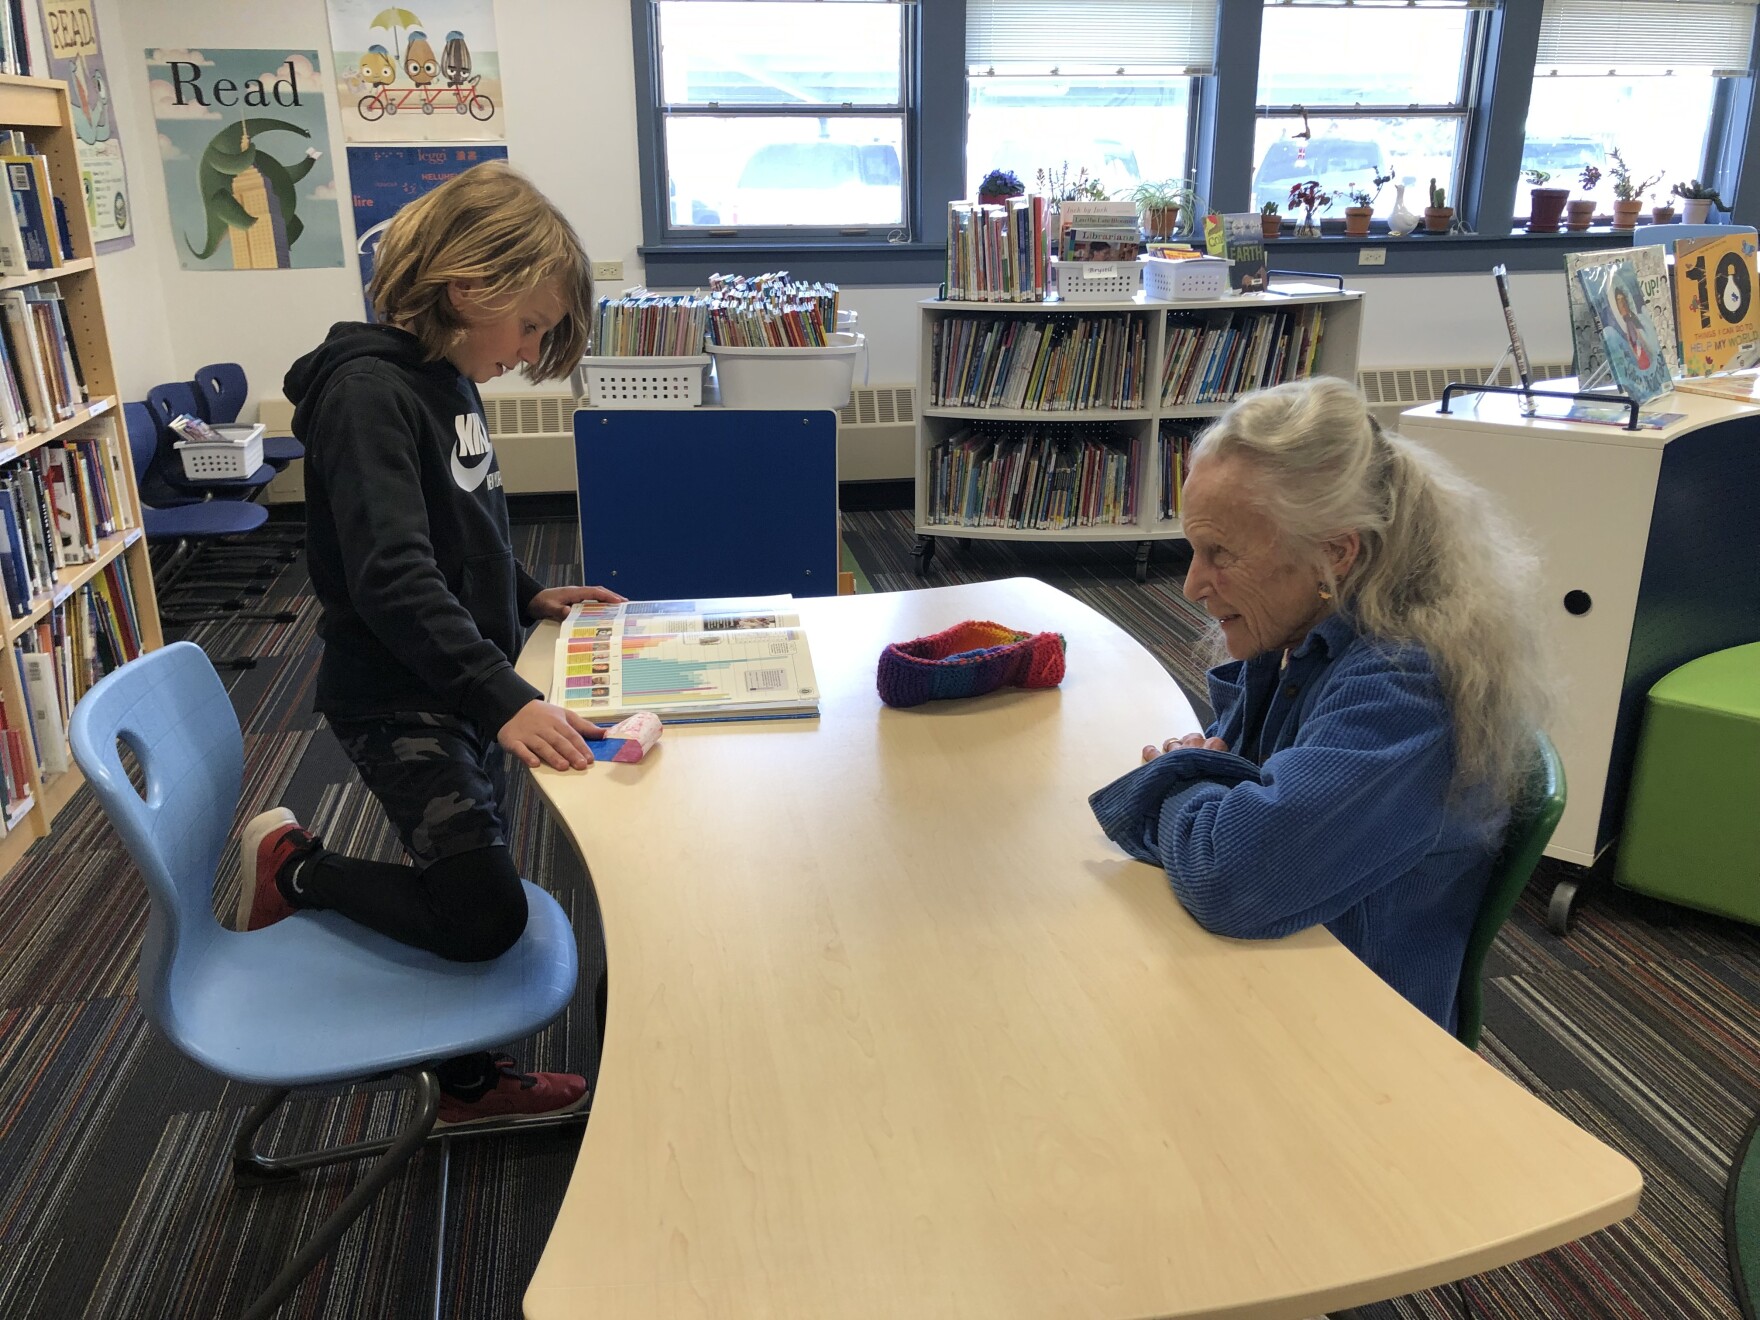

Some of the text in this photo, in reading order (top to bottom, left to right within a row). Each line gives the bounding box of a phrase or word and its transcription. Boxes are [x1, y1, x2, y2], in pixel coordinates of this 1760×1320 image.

[166, 61, 304, 108] Read
[418, 149, 447, 165] leggi
[353, 194, 374, 207] lire
[1082, 231, 1135, 242] Librarians
[1230, 245, 1263, 262] EARTH
[1644, 277, 1660, 297] UP!
[1685, 251, 1752, 329] 10
[1694, 330, 1717, 340] THINGS
[1722, 327, 1735, 336] CAN
[1735, 325, 1744, 333] DO
[1745, 323, 1754, 331] TO
[1690, 330, 1759, 353] HELP MY WORLD
